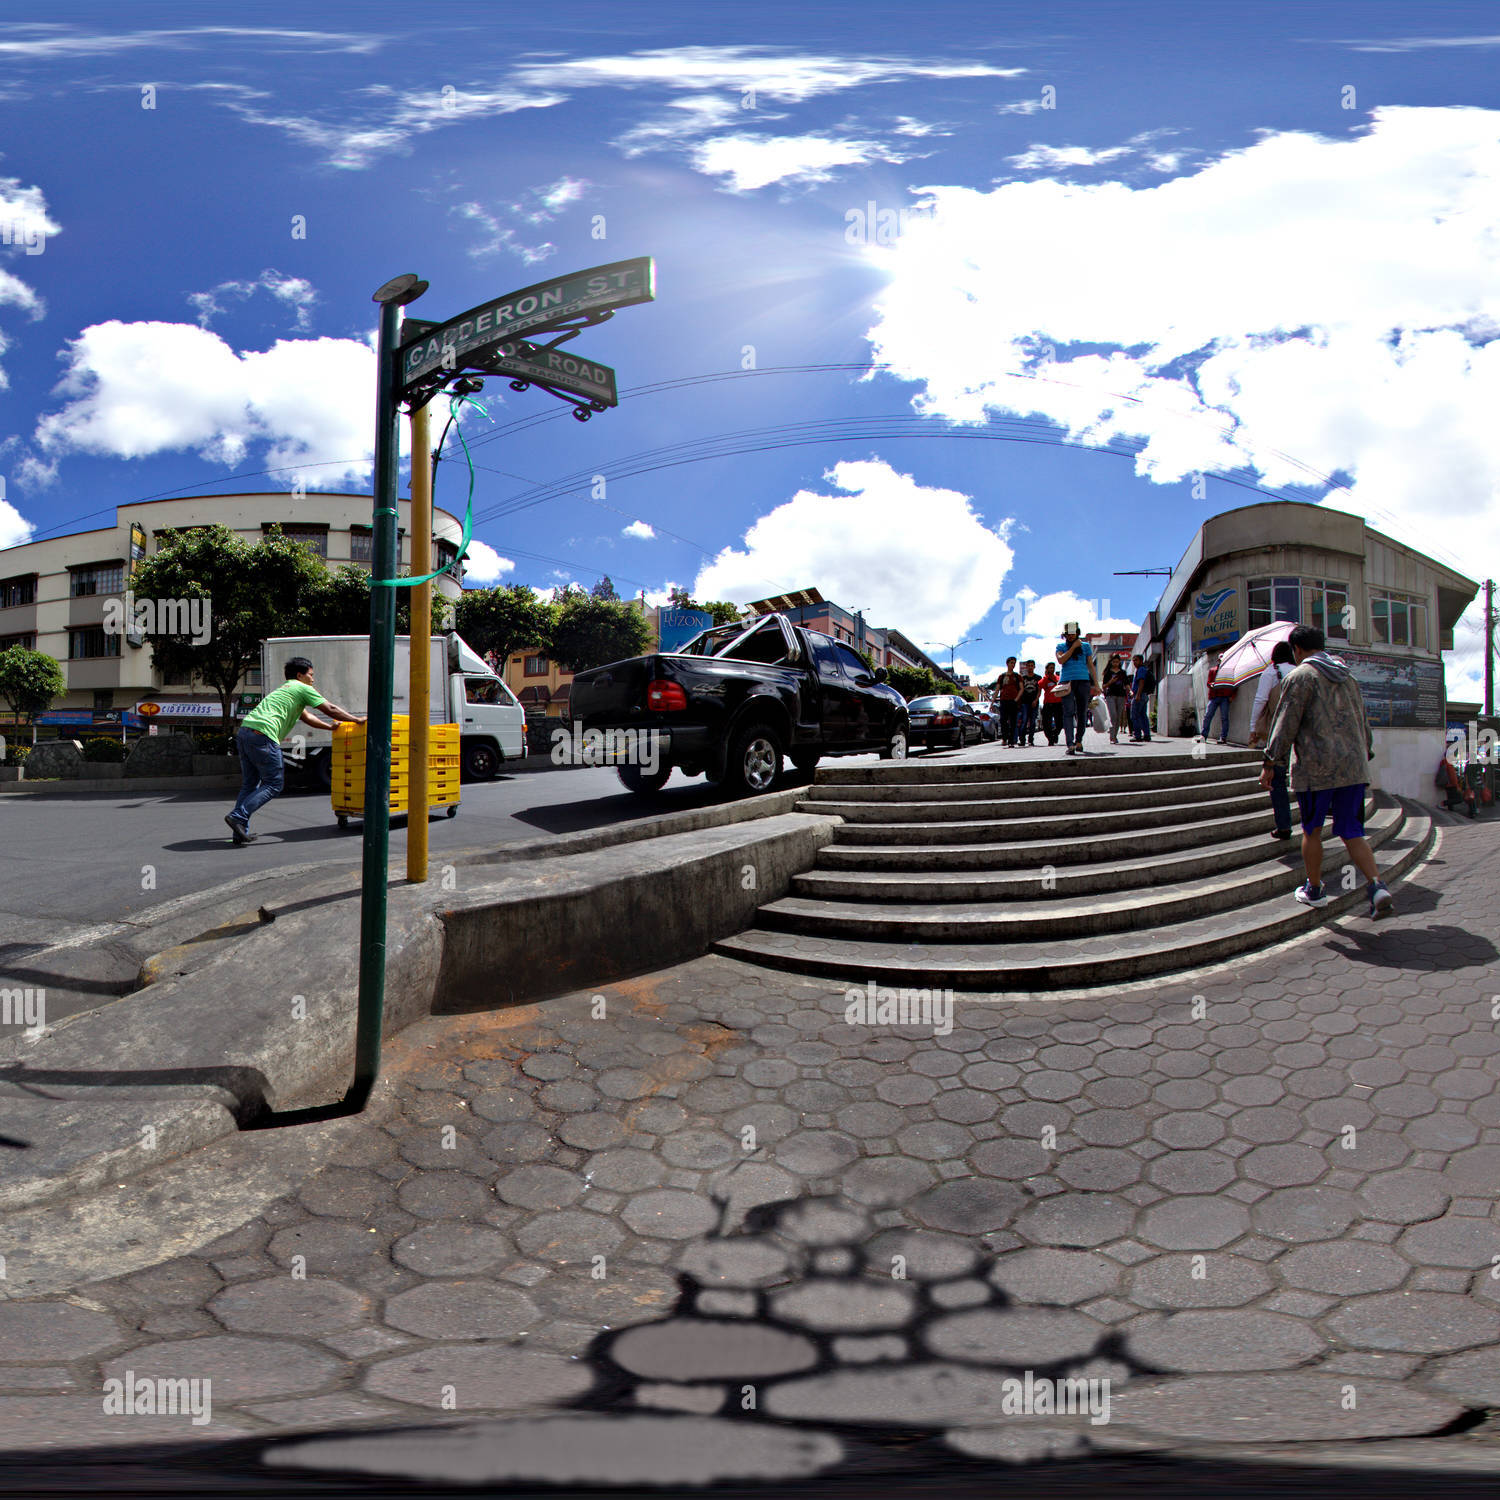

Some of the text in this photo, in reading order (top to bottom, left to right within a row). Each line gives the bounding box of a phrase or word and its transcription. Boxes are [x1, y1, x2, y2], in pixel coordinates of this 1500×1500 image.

[547, 353, 607, 385] ROAD
[663, 611, 705, 628] LUZON
[1213, 608, 1238, 624] CEBU
[1203, 619, 1236, 635] PACIFIC
